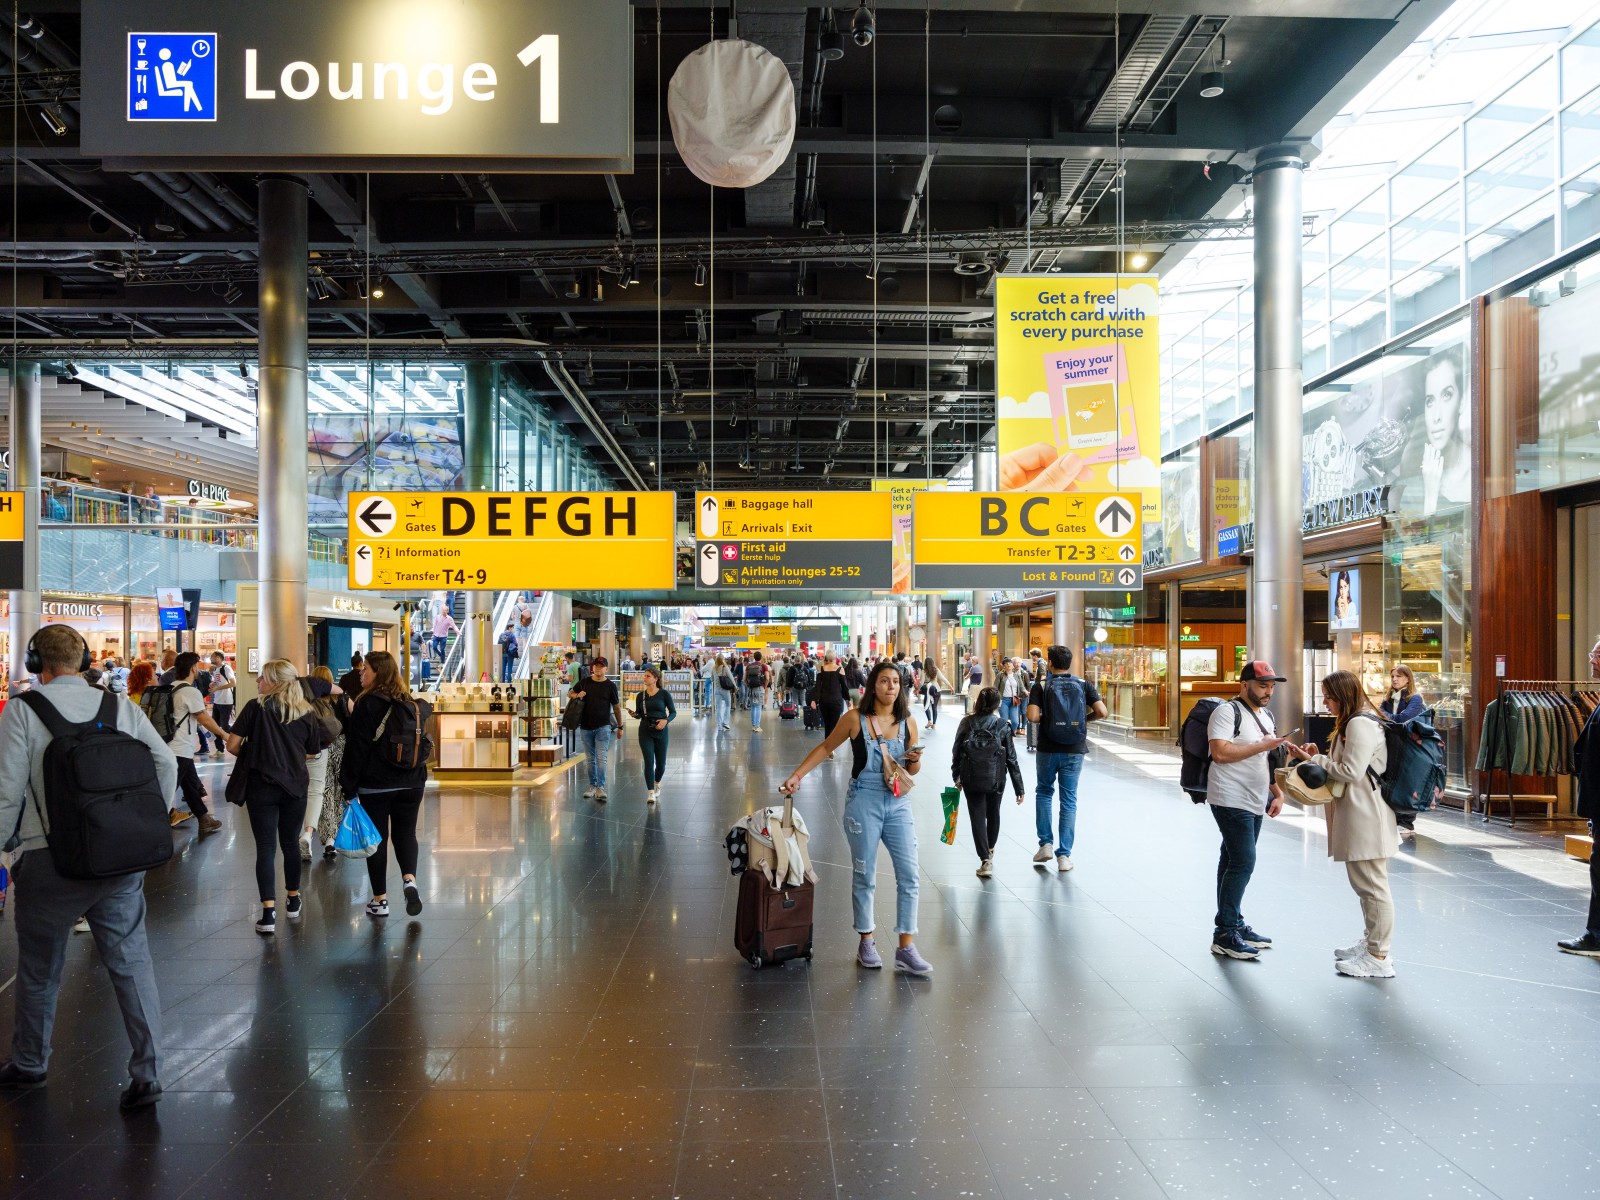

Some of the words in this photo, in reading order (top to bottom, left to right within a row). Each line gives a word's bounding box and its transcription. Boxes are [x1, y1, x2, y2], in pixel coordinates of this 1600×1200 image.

[245, 49, 498, 116] Lounge
[516, 34, 559, 123] 1
[1038, 291, 1066, 305] Get
[1070, 294, 1079, 305] a
[1083, 291, 1116, 305] free
[1010, 308, 1066, 321] scratch
[1070, 308, 1104, 321] card
[1109, 308, 1145, 321] with
[1022, 327, 1067, 341] every
[1071, 324, 1144, 341] purchase
[1056, 357, 1086, 370] Enjoy
[1088, 354, 1114, 368] your
[1064, 366, 1109, 380] summer
[741, 499, 789, 511] Baggage
[793, 499, 813, 509] hall
[1312, 484, 1386, 528] JEWELRY
[405, 522, 436, 533] Gates
[741, 523, 784, 533] Arrivals
[792, 523, 813, 533] Exit
[1055, 523, 1087, 533] Gates
[1218, 528, 1239, 542] GASSAN
[395, 547, 461, 558] Information
[741, 542, 766, 552] First
[769, 542, 786, 552] aid
[1007, 547, 1051, 557] Transfer
[1055, 545, 1096, 561] T2-3
[765, 553, 781, 562] hulp
[395, 571, 439, 581] Transfer
[442, 569, 487, 585] T4-9
[741, 566, 779, 576] Airline
[782, 566, 826, 579] lounges
[829, 566, 861, 576] 25-52
[1022, 571, 1047, 581] Lost
[1049, 571, 1059, 581] &
[1061, 571, 1096, 581] Found
[741, 578, 750, 586] By
[751, 577, 786, 585] invitation
[787, 577, 803, 586] only
[42, 602, 103, 617] ECTRONICS
